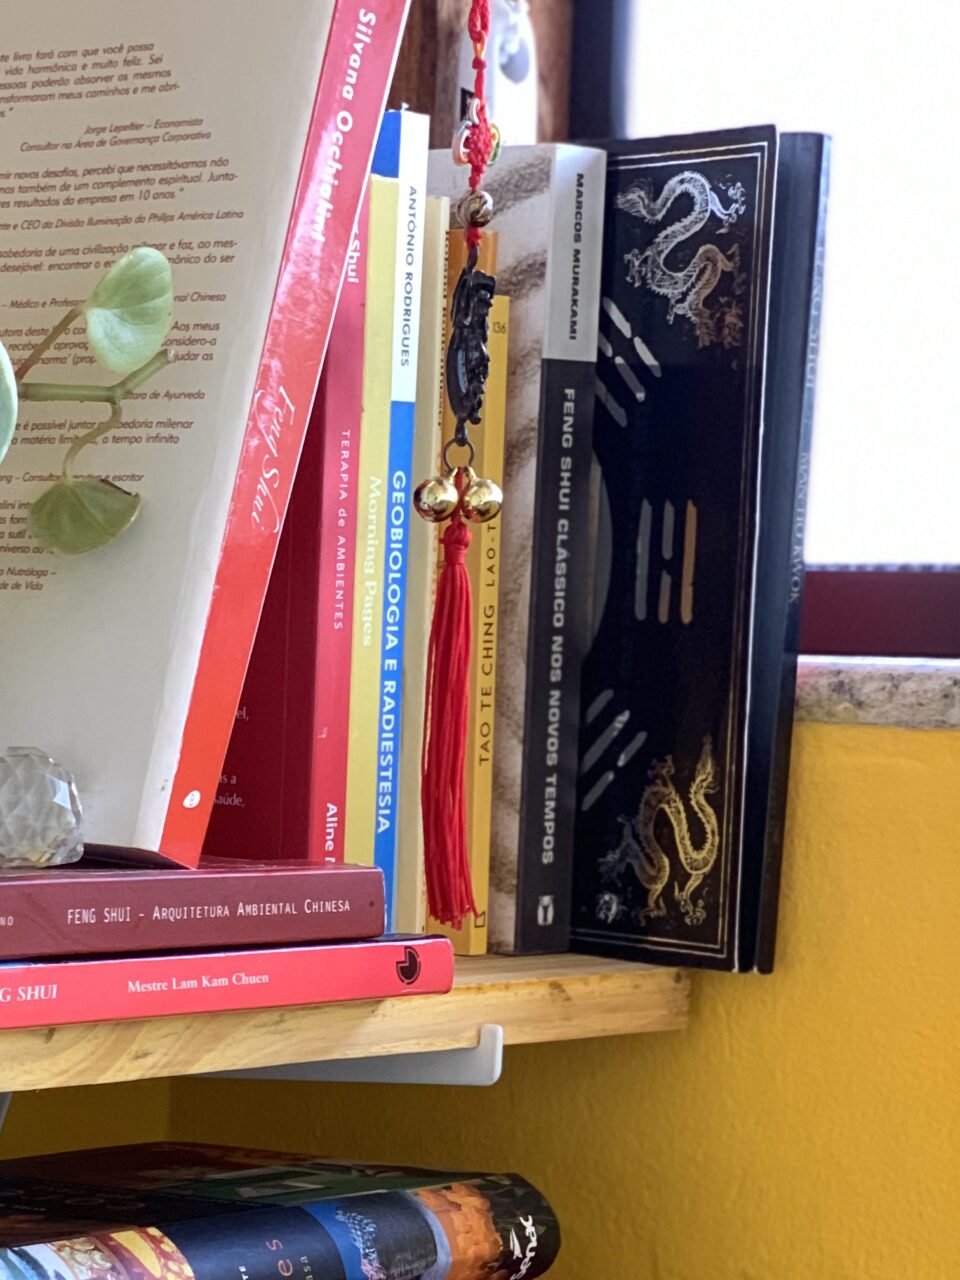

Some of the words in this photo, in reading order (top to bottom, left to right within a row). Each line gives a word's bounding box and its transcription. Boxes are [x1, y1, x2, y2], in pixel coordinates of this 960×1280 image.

[4, 65, 23, 76] vida
[27, 62, 77, 74] harmônica
[91, 58, 118, 69] muito
[122, 55, 142, 67] feliz.
[147, 52, 163, 65] Sei
[12, 50, 32, 61] livro
[34, 48, 54, 60] fará
[56, 49, 78, 59] com
[80, 47, 99, 58] que
[101, 42, 124, 55] você
[125, 42, 154, 55] possa
[31, 76, 70, 89] poderão
[73, 74, 114, 85] absorver
[117, 72, 128, 82] os
[132, 69, 171, 79] mesmos
[341, 8, 376, 101] Silvana
[57, 90, 83, 100] meus
[84, 86, 130, 98] caminhos
[140, 84, 157, 93] me
[157, 80, 180, 92] abri-
[311, 111, 354, 244] Occhialini
[573, 173, 585, 244] MARCOS
[403, 186, 418, 266] ANTÓNIO
[400, 271, 414, 368] RODRIGUES
[568, 248, 581, 341] MURAKAMI
[561, 388, 575, 448] FENG
[339, 429, 351, 502] TERAPIA
[558, 454, 573, 514] SHUI
[337, 507, 347, 528] de
[363, 476, 381, 575] Morning
[333, 535, 345, 631] AMBIENTES
[385, 470, 405, 651] GEOBIOLOGIA
[485, 523, 498, 588] LAO-T
[552, 519, 570, 628] CLÁSSICO
[362, 581, 377, 647] Pages
[481, 604, 495, 677] CHING
[383, 658, 397, 672] E
[548, 636, 564, 683] NOS
[480, 684, 493, 713] TE
[544, 694, 561, 767] NOVOS
[377, 680, 396, 833] RADIESTESIA
[478, 721, 492, 767] TAO
[325, 803, 338, 851] Aline
[541, 772, 558, 865] TEMPOS
[67, 906, 97, 926] FENG
[102, 904, 132, 924] SHUI
[152, 900, 231, 922] ARQUITETURA
[236, 898, 297, 918] AMBIENTAL
[302, 896, 351, 915] CHINESA
[16, 982, 58, 1005] SHUI
[127, 978, 169, 994] Mestre
[171, 976, 197, 991] Lam
[200, 974, 229, 990] Kam
[231, 971, 269, 988] Chuen
